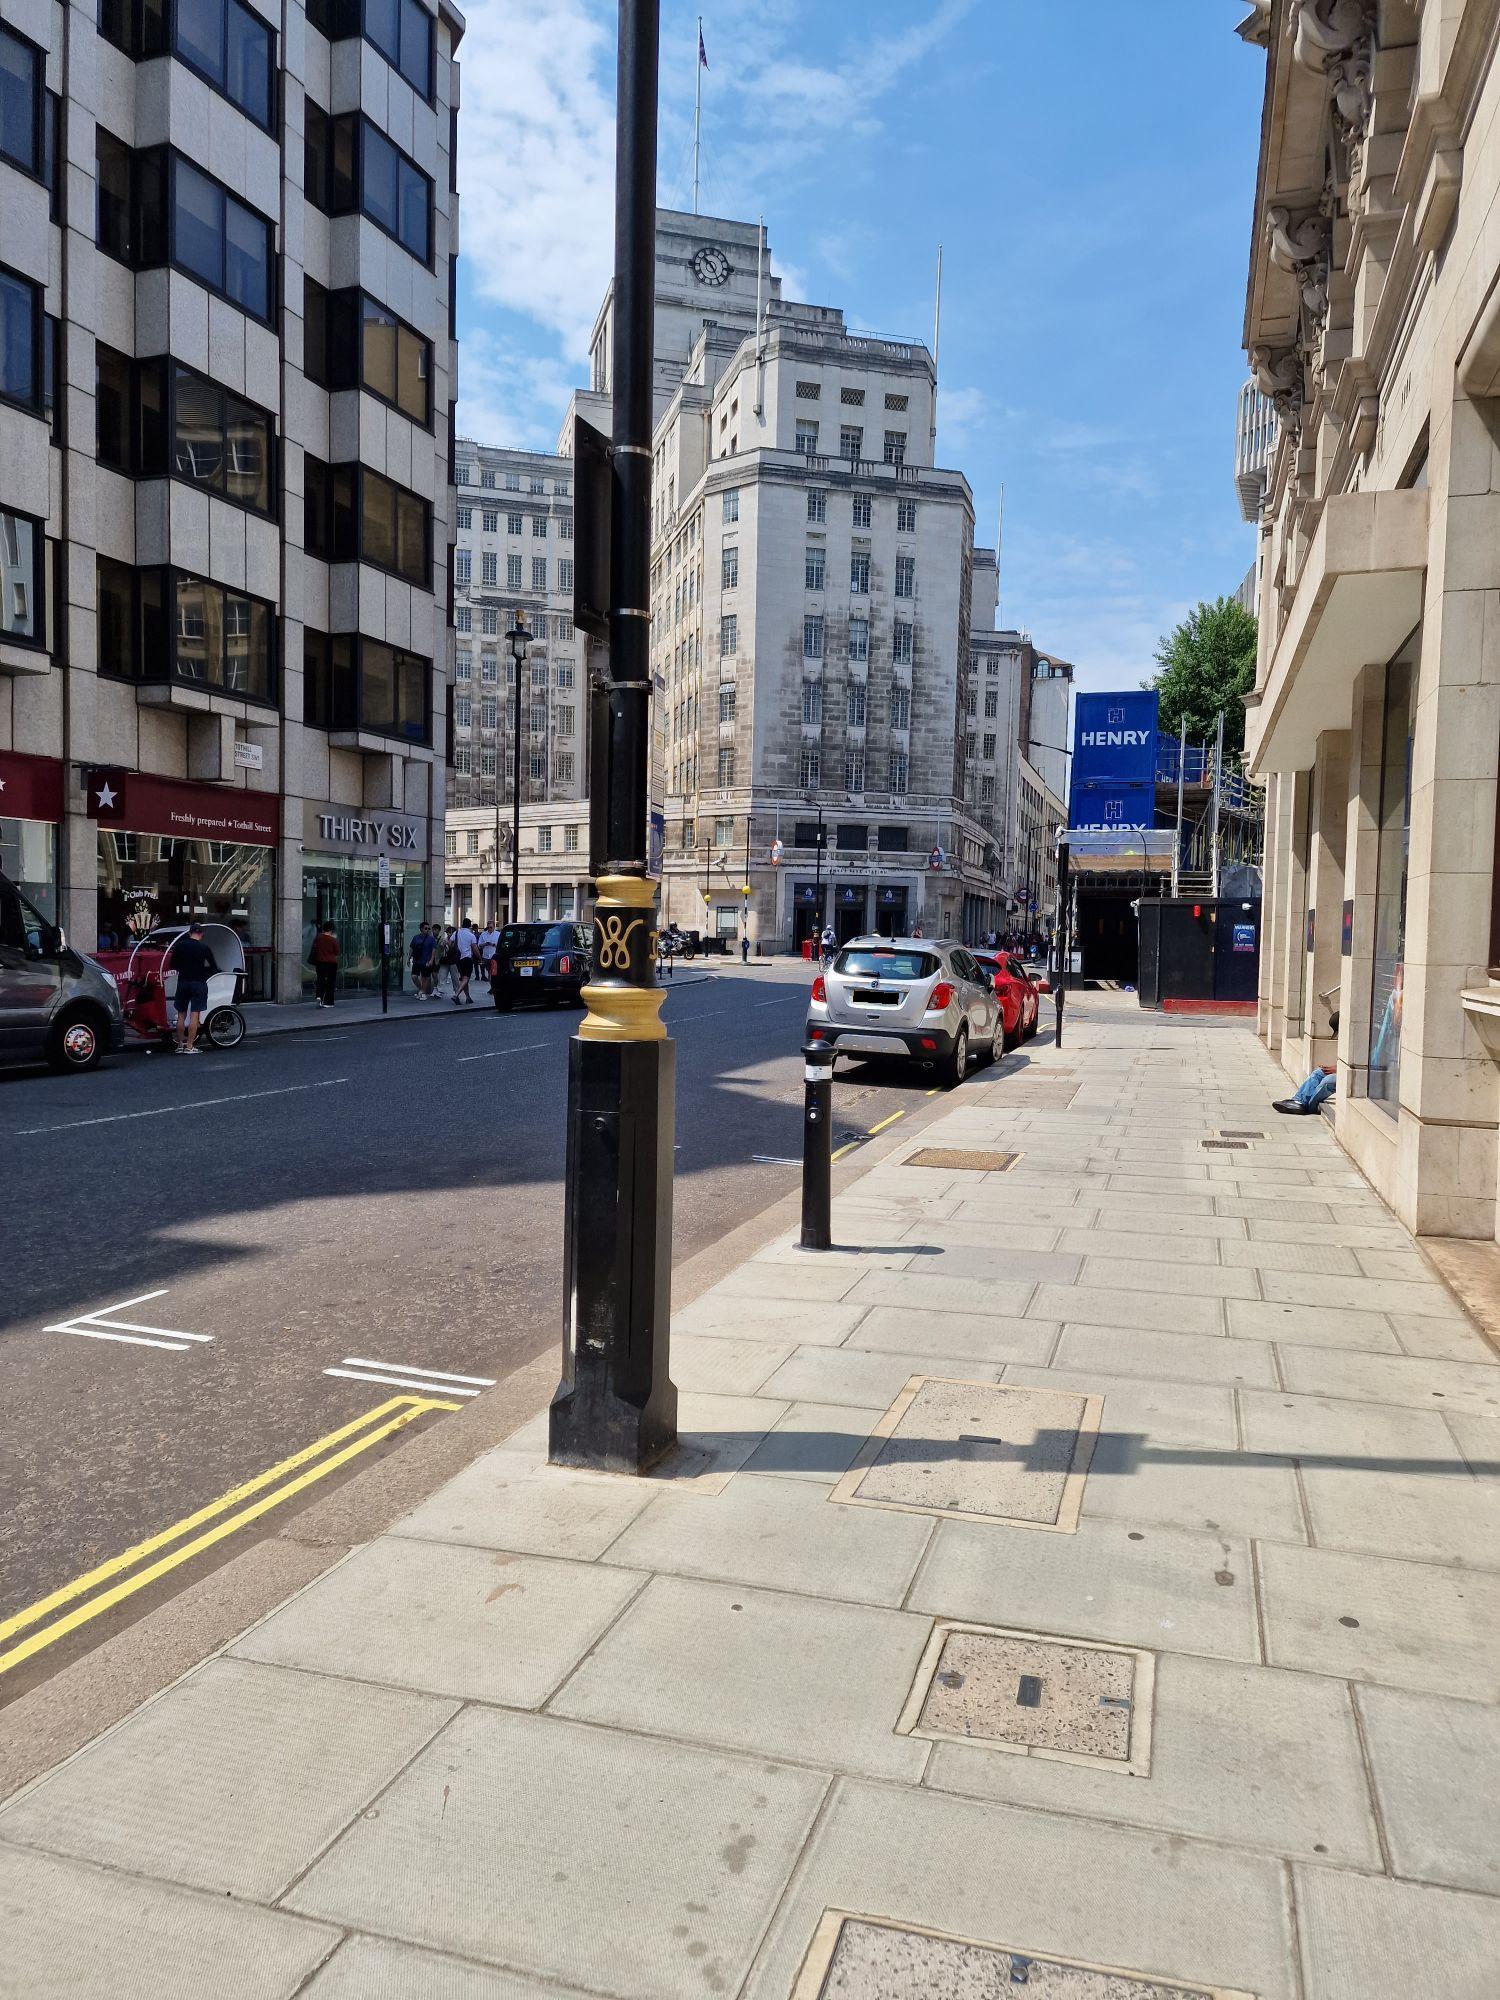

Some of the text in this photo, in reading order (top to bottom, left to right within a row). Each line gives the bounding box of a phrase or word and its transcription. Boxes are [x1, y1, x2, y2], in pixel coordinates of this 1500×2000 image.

[1081, 730, 1150, 746] HENRY
[235, 743, 252, 752] TOTHILL
[235, 751, 251, 759] STREET
[171, 812, 272, 832] Freshly prepared Tothill Street
[320, 814, 417, 848] THIRTY SIX
[129, 890, 144, 898] Club
